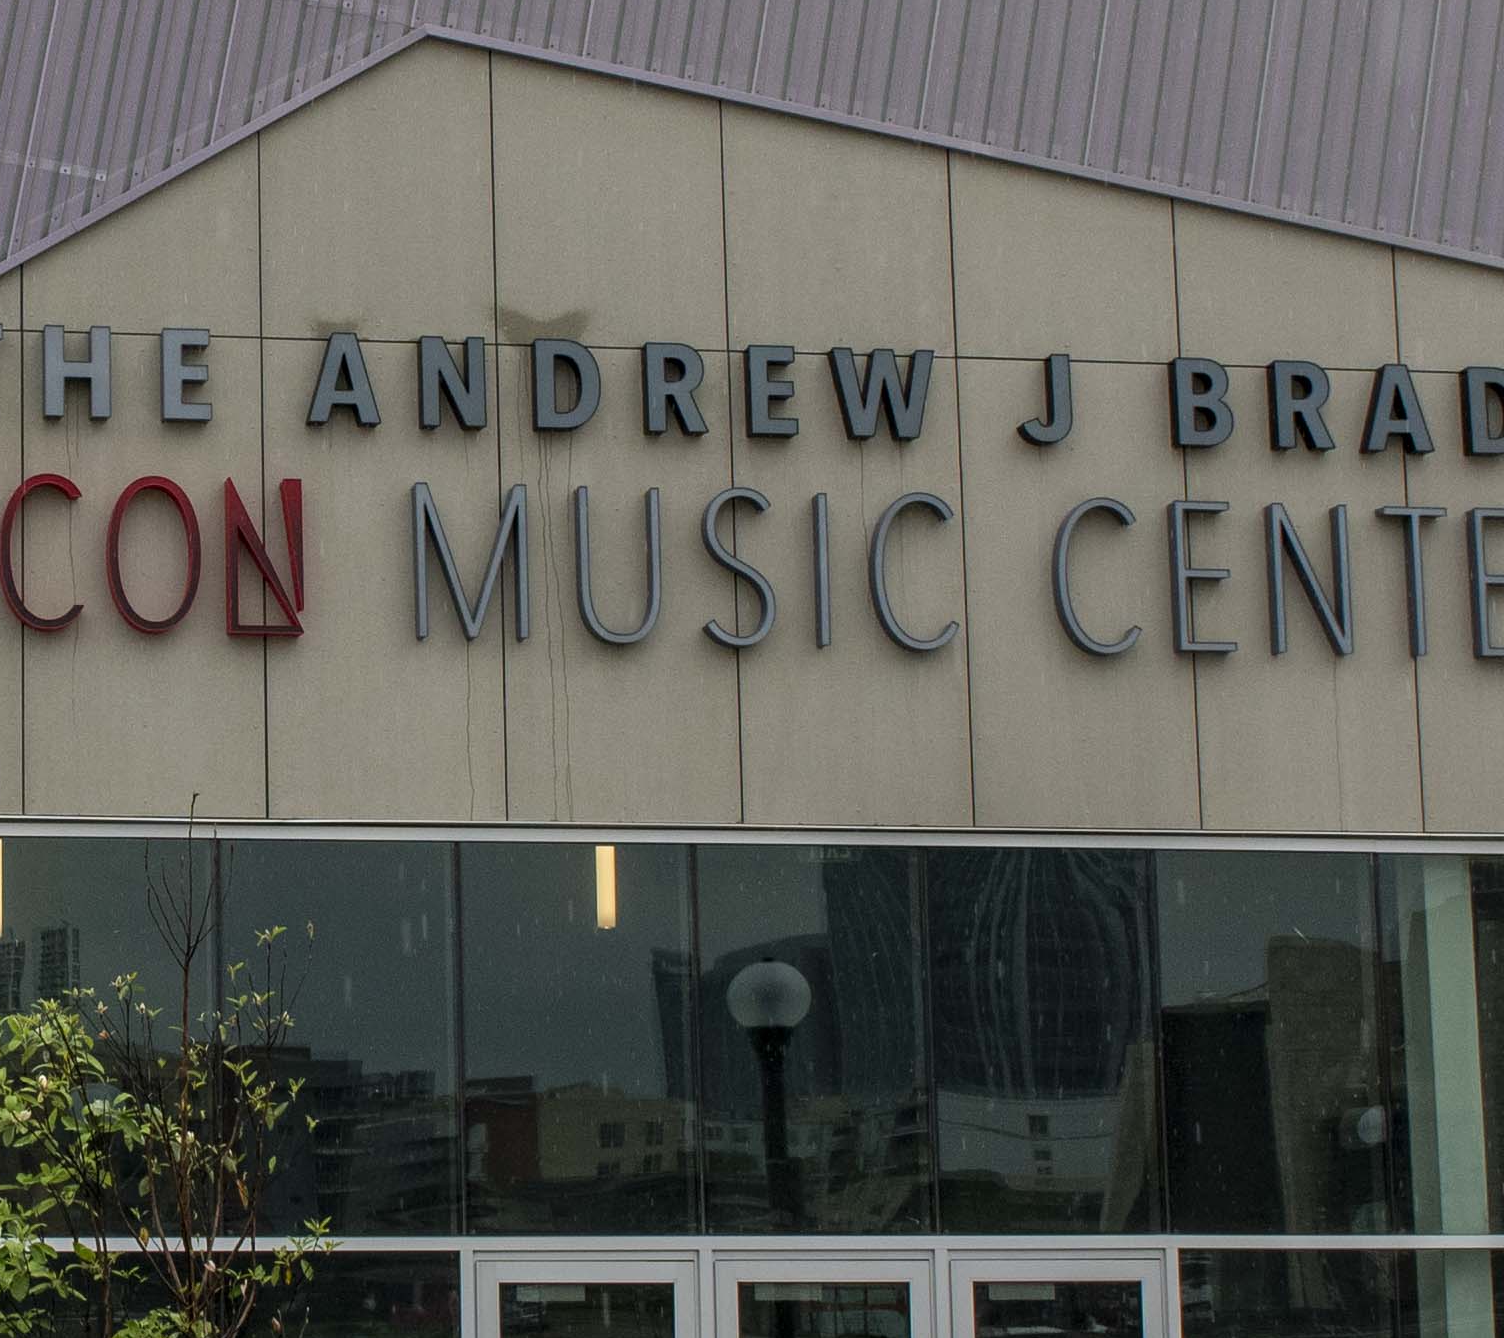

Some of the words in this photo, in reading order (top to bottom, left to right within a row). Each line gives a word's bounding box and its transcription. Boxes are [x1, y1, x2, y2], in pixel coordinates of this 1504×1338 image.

[305, 332, 935, 441] ANDREW
[1016, 354, 1071, 446] J
[412, 481, 960, 653] MUSIC
